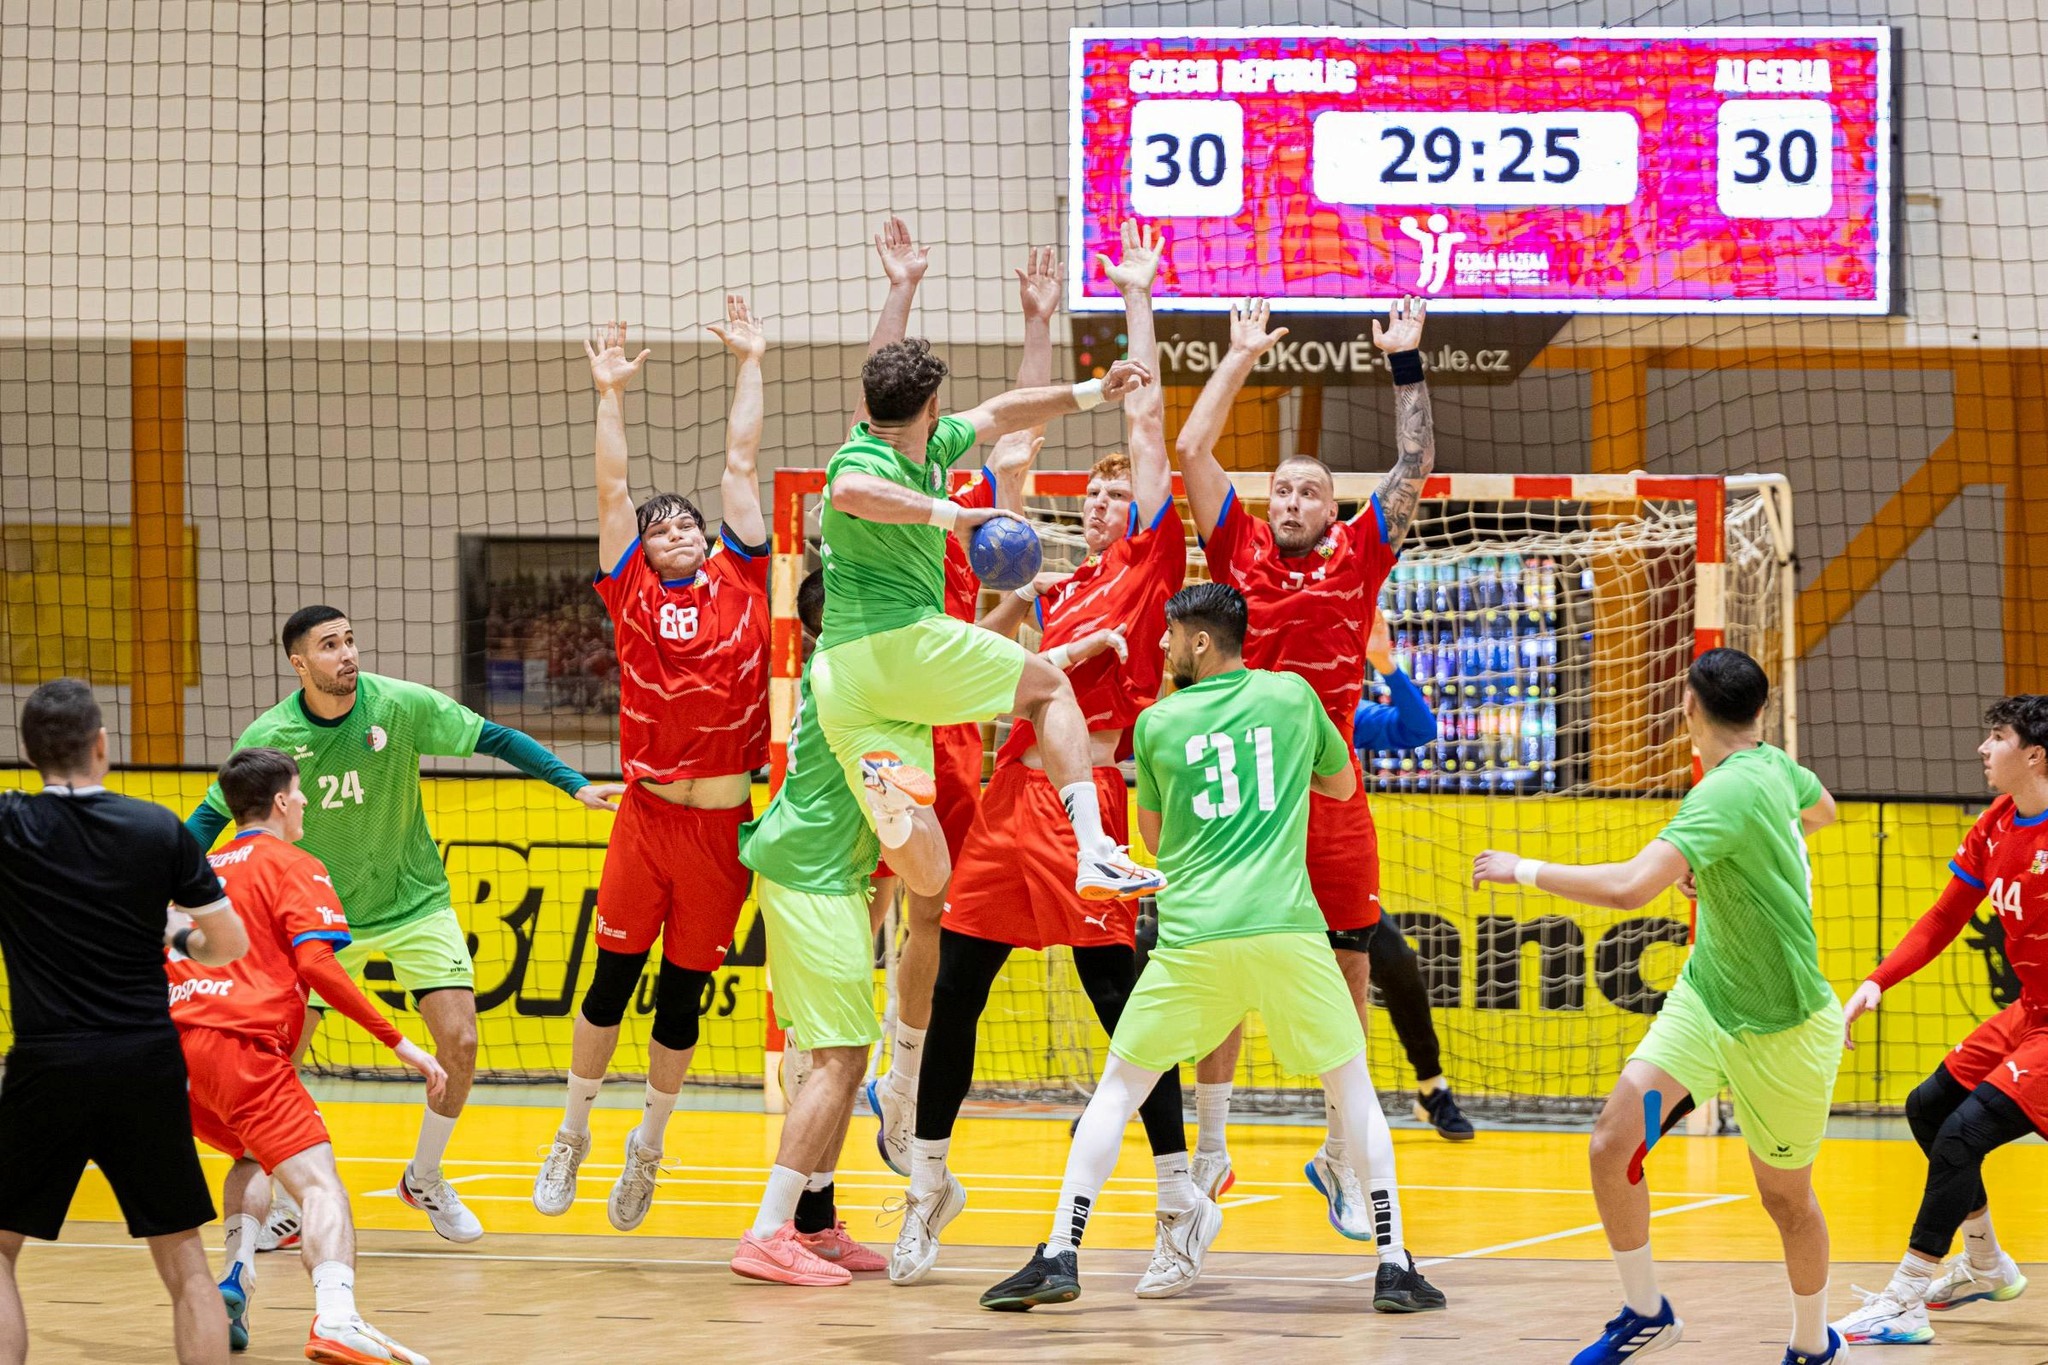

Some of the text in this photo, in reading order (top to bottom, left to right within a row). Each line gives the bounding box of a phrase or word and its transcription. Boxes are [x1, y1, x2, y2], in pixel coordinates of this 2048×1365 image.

[1713, 59, 1832, 93] ALGERIA
[1145, 133, 1226, 187] 30
[1380, 126, 1580, 183] 29:25
[1734, 129, 1817, 184] 30
[660, 602, 698, 640] 88
[318, 770, 365, 809] 24
[1185, 726, 1276, 820] 31
[1988, 876, 2023, 921] 44
